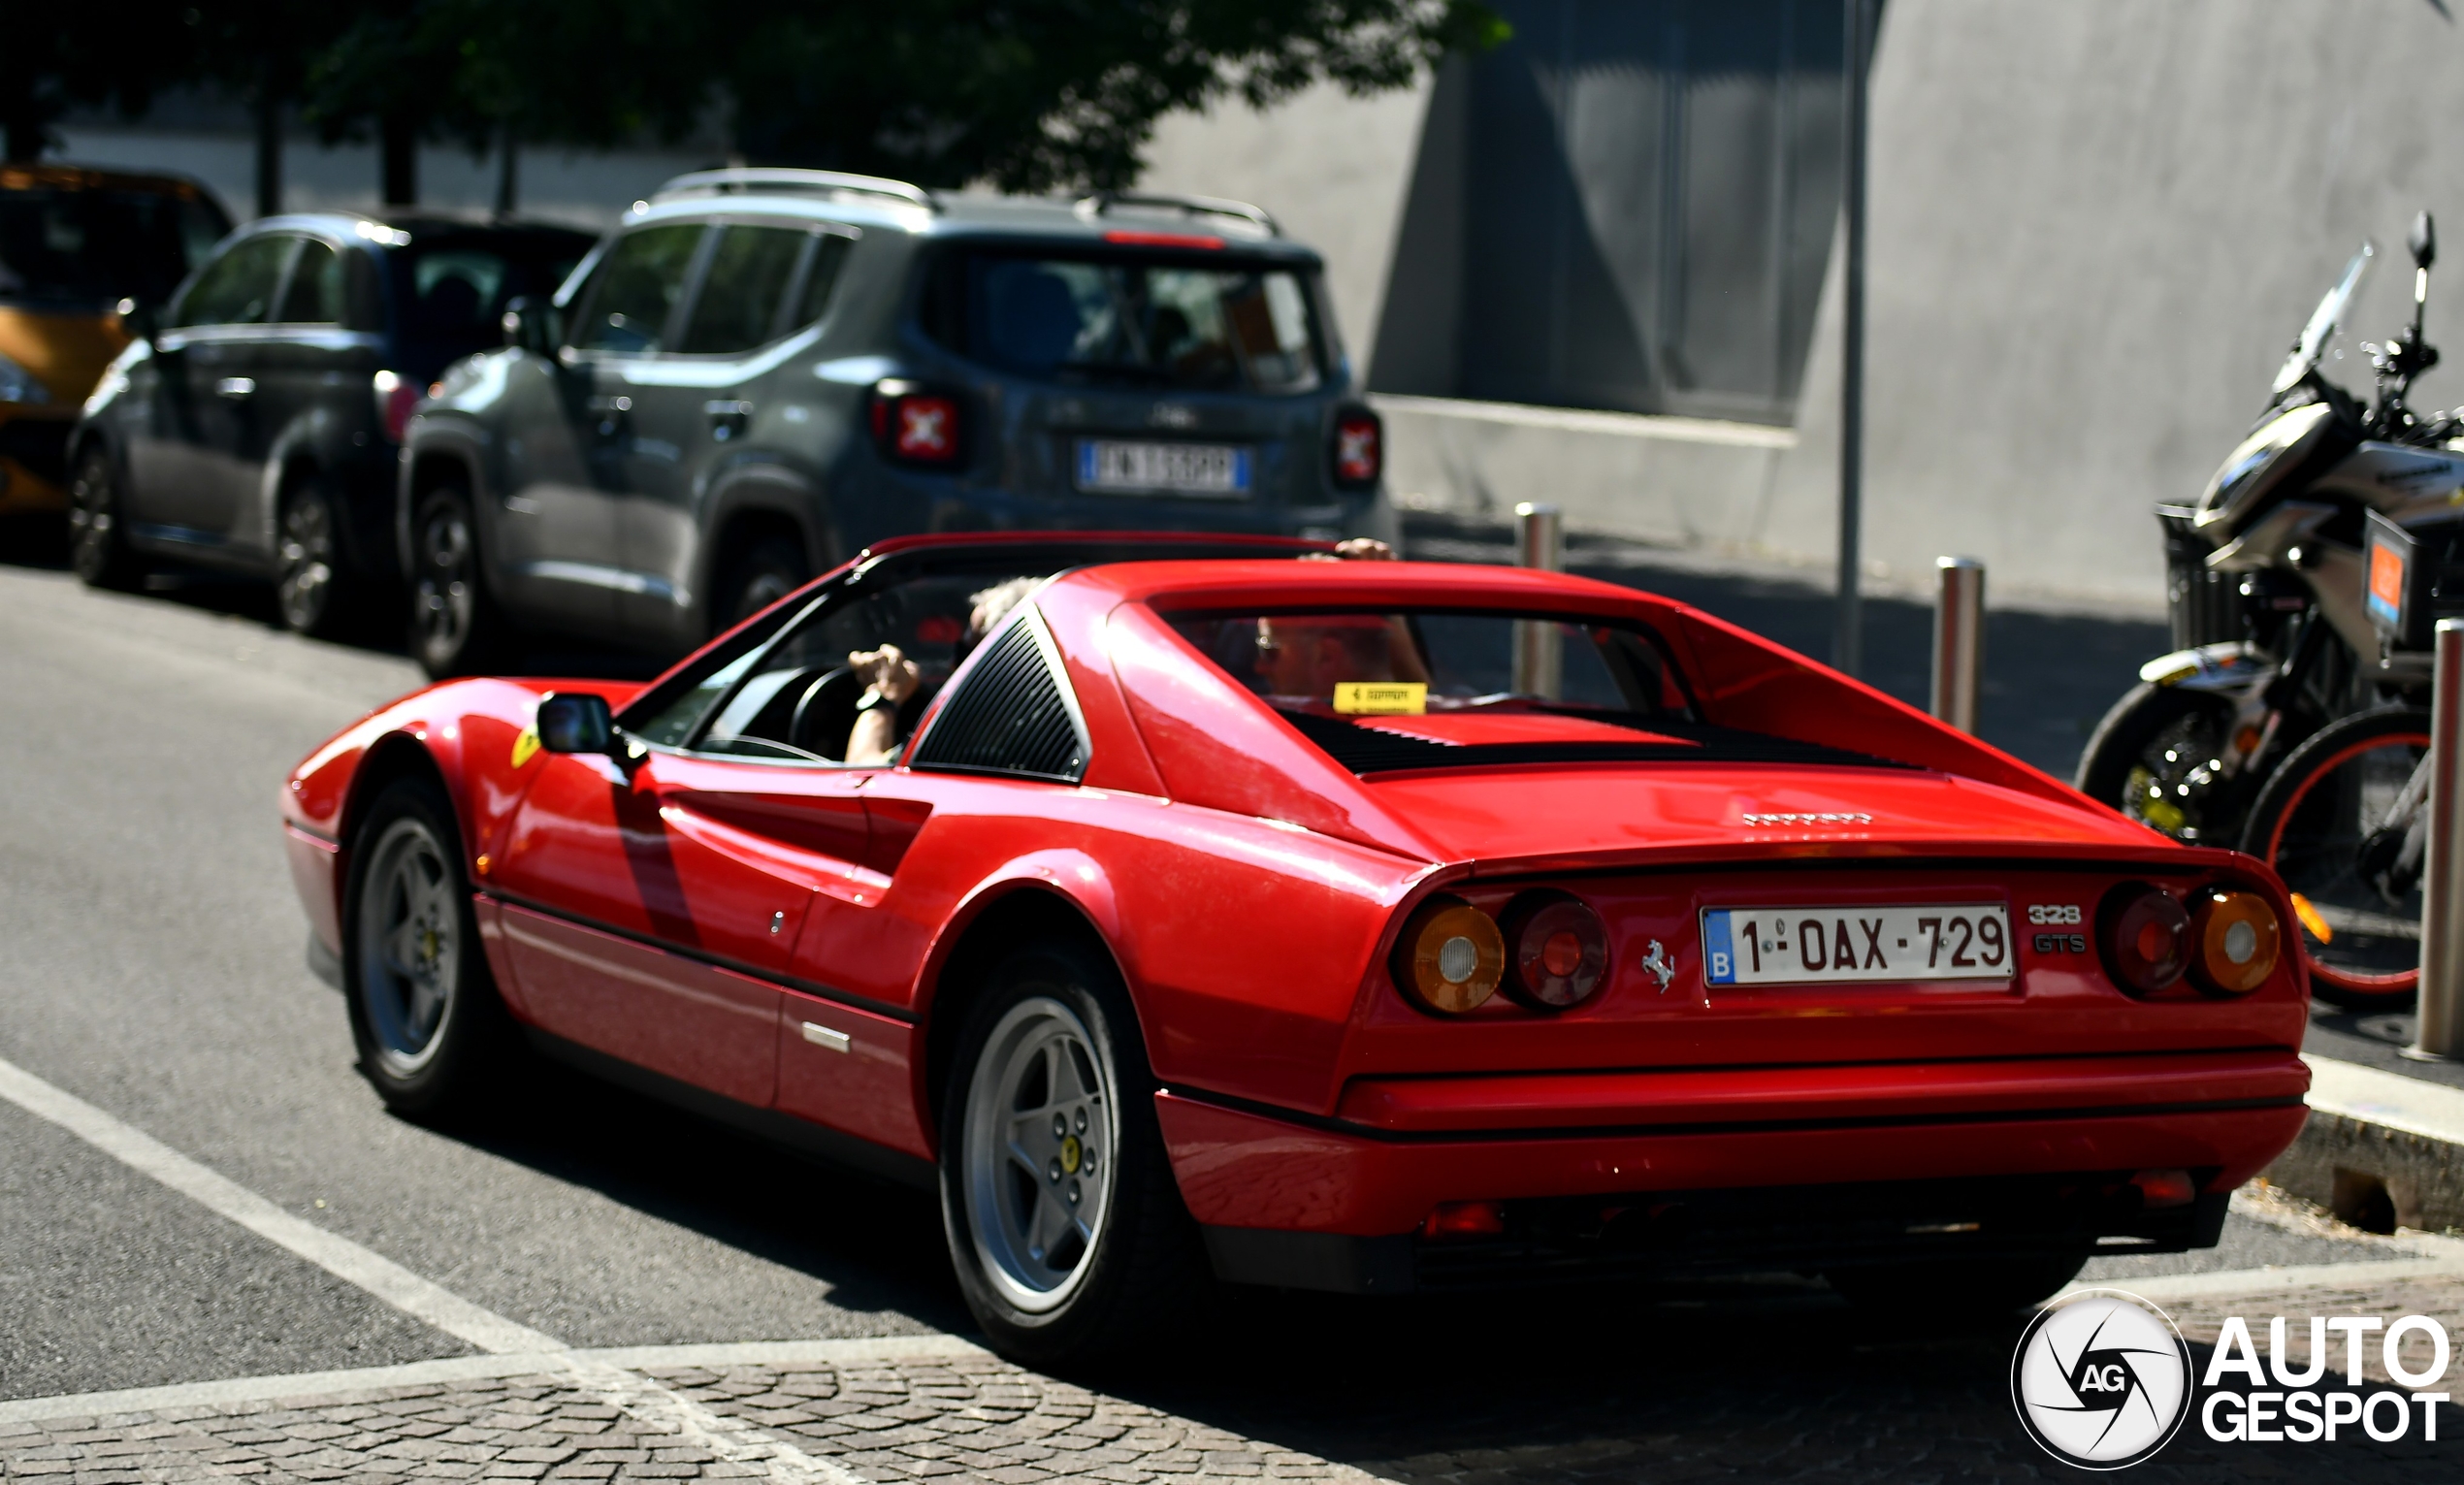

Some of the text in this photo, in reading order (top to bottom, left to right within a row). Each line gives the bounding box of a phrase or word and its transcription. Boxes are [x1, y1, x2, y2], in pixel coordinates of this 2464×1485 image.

[2028, 904, 2082, 925] 328
[2034, 933, 2086, 953] GTS
[1712, 952, 1731, 978] B
